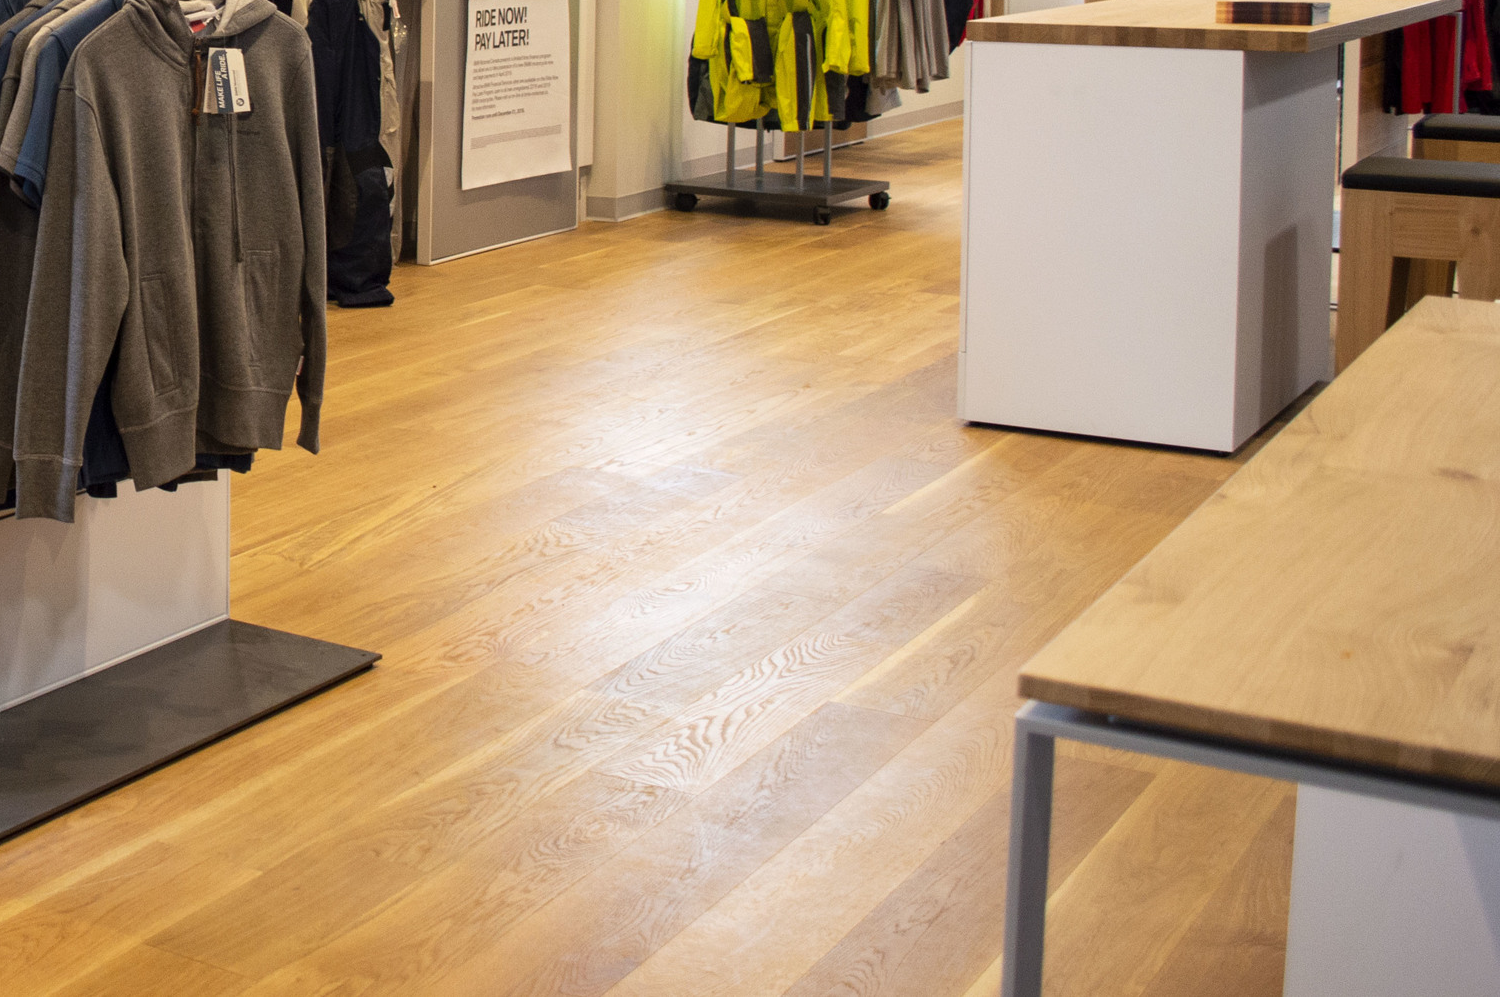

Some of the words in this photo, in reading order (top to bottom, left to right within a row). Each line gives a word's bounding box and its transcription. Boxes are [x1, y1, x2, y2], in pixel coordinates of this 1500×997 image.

[475, 9, 497, 28] RIDE
[498, 6, 528, 25] NOW!
[475, 32, 492, 51] PAY
[493, 29, 530, 48] LATER!
[215, 70, 223, 86] LIFE
[217, 86, 226, 109] MAKE
